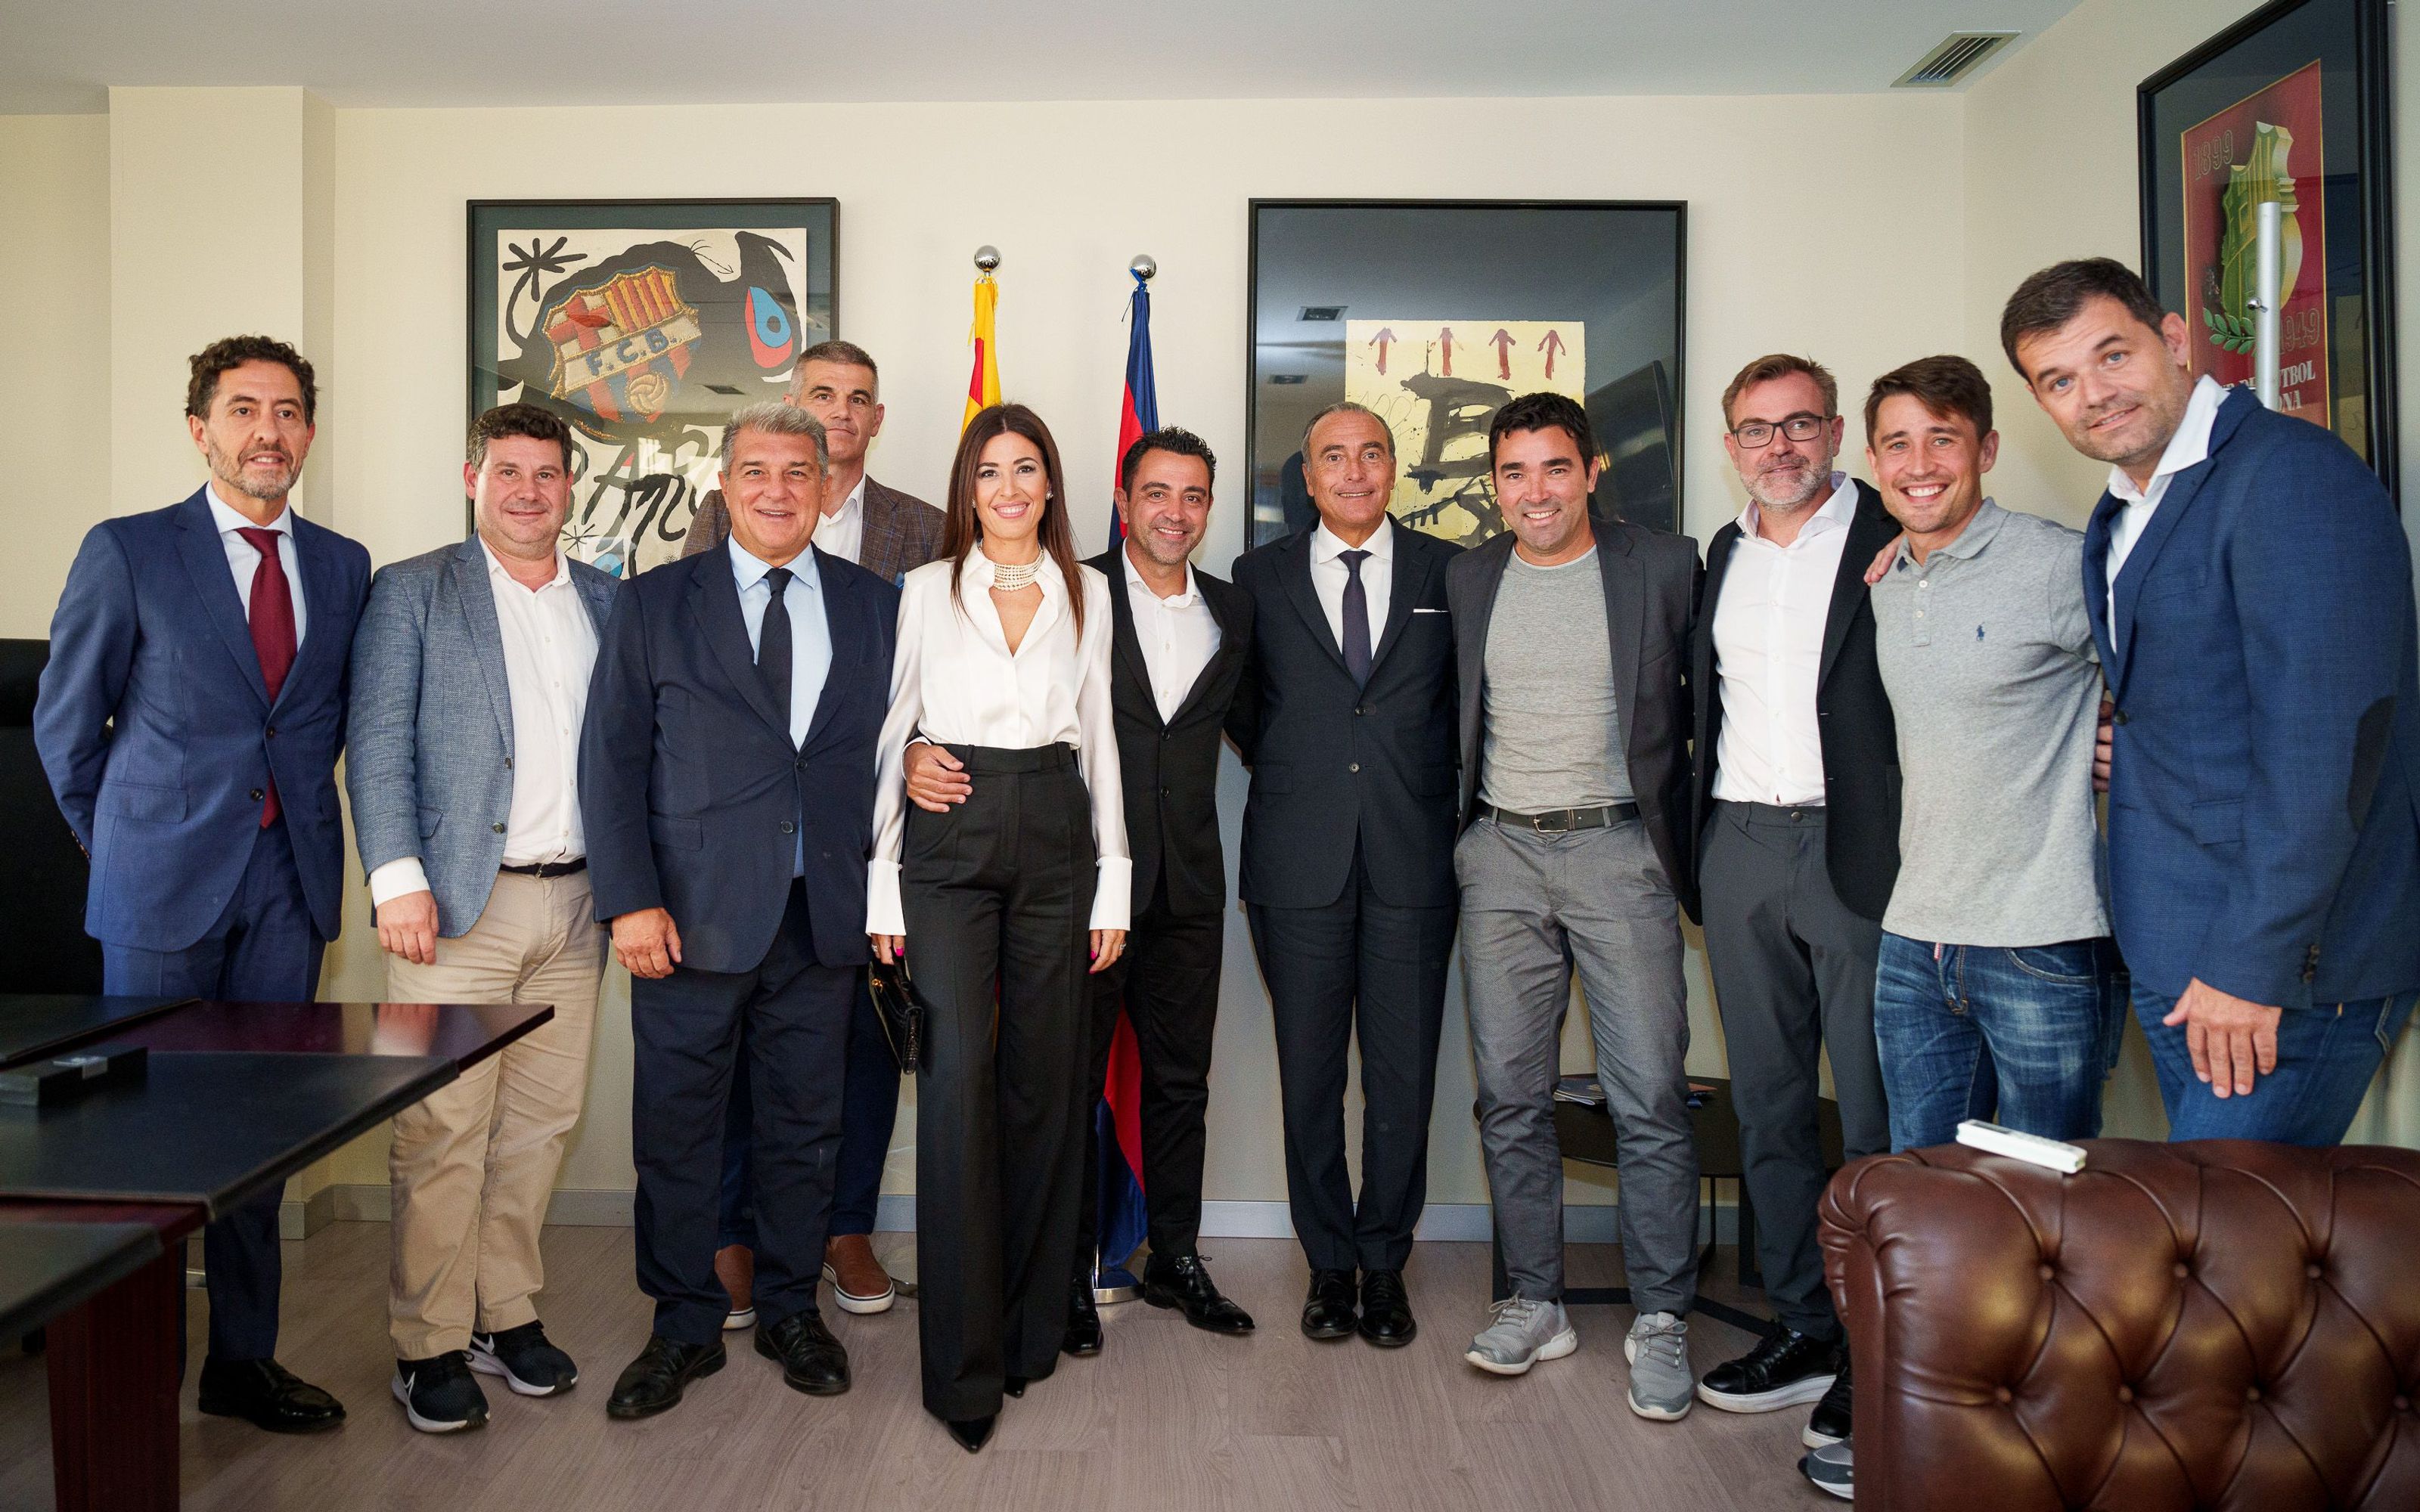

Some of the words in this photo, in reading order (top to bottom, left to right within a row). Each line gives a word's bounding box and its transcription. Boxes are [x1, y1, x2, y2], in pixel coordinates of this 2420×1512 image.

[2194, 129, 2232, 180] 1899
[586, 328, 678, 376] F.C.B.
[2279, 361, 2316, 388] TBOL
